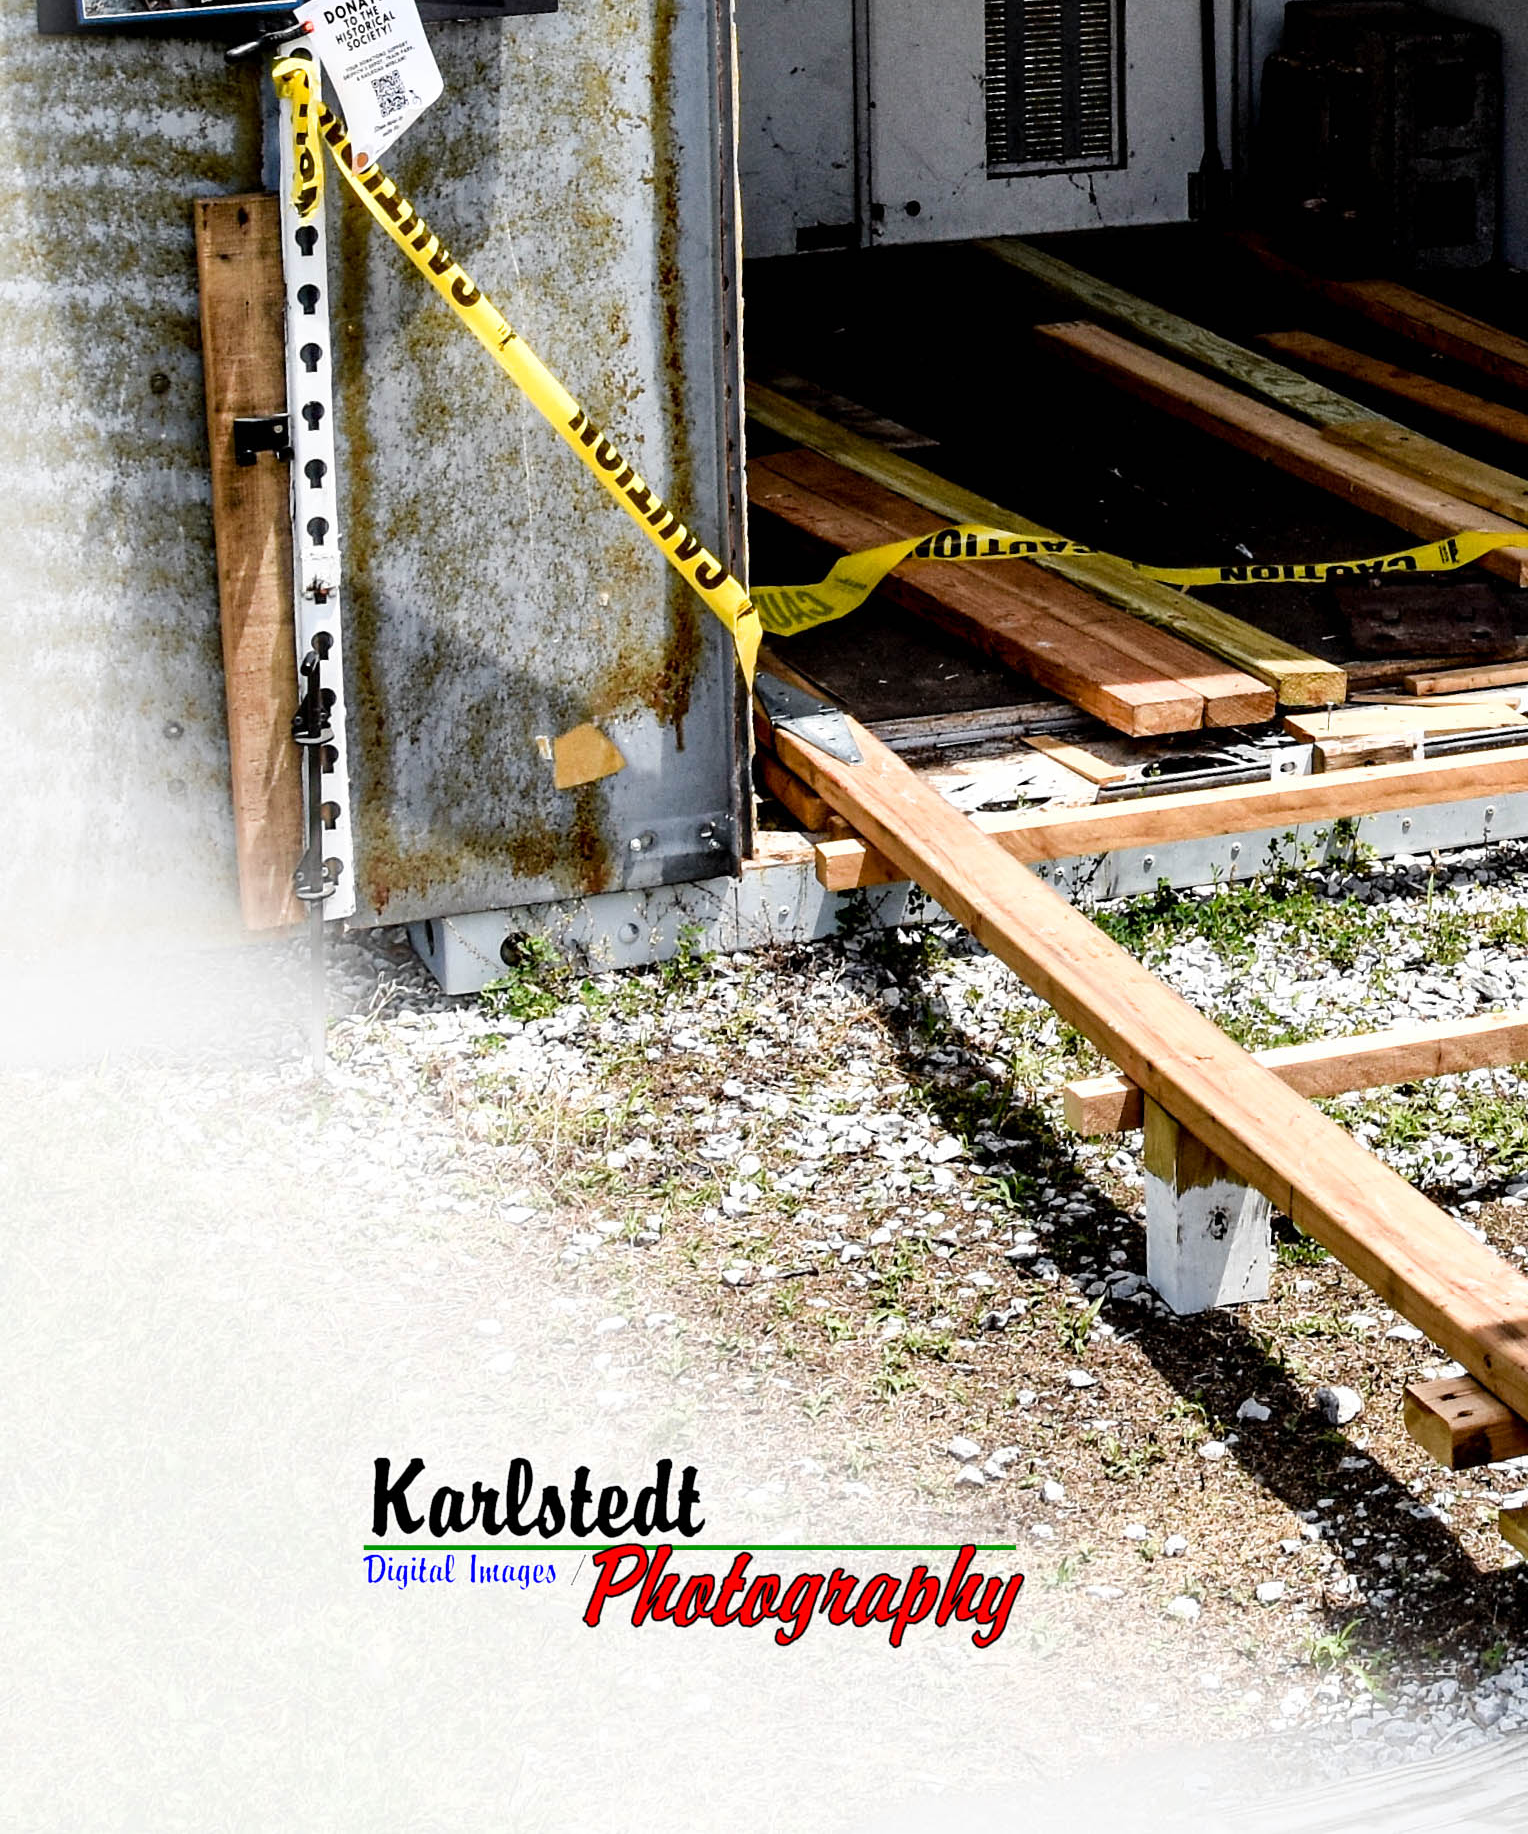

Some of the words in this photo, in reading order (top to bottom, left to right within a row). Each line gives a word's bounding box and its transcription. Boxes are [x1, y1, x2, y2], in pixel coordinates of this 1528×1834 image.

[335, 10, 397, 45] HISTORICAL
[343, 17, 358, 29] TO
[360, 5, 380, 23] THE
[346, 24, 393, 51] SOCIETY!
[1219, 554, 1416, 583] CAUTION
